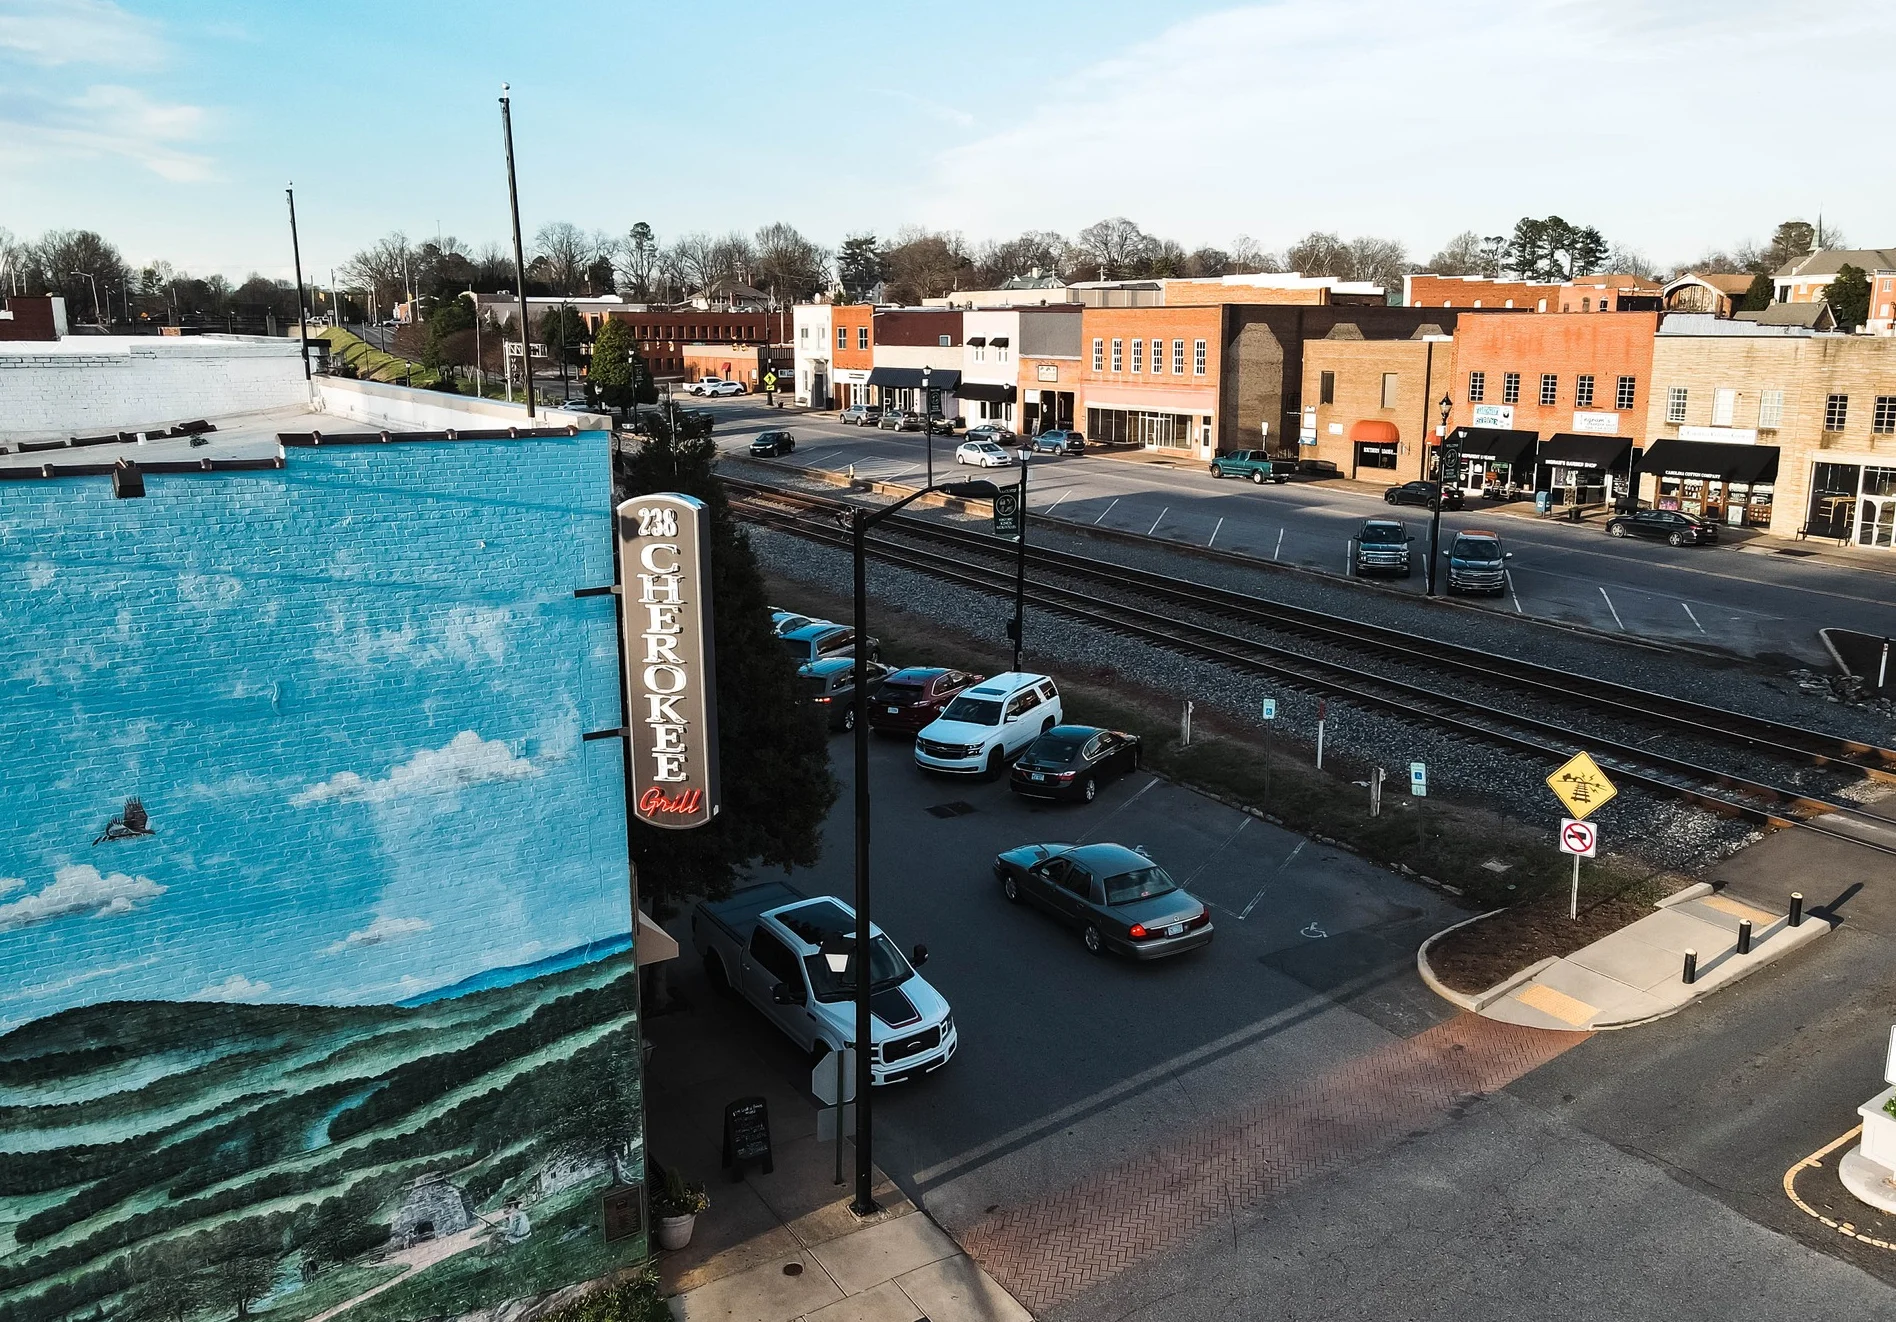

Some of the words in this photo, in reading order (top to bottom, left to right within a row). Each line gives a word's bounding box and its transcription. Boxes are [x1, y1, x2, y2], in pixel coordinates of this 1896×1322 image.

[637, 507, 680, 538] 238
[636, 543, 689, 783] CHEROKEE
[639, 785, 703, 818] Grill
